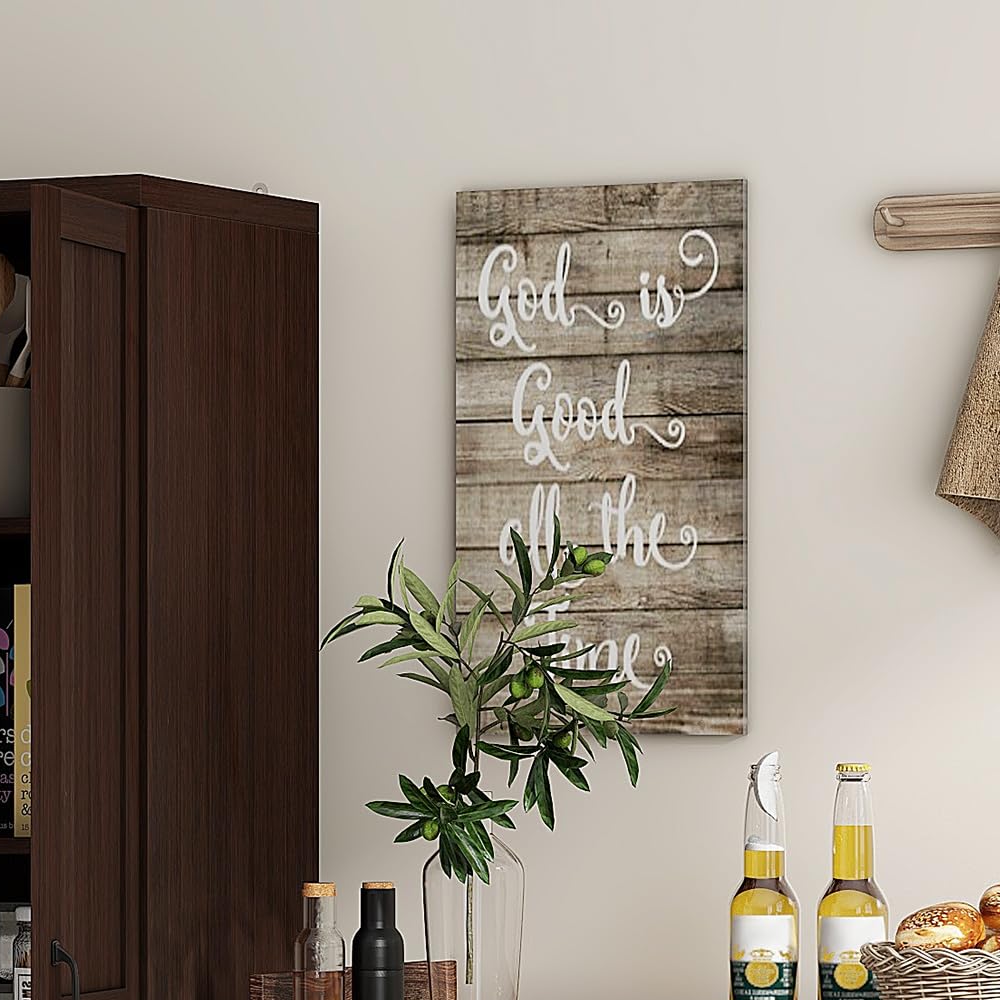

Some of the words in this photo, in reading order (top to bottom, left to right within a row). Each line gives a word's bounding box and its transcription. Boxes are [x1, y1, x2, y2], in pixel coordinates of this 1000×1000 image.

[478, 241, 625, 352] God
[639, 229, 721, 328] is
[512, 359, 687, 472] Good
[499, 482, 578, 586] all
[588, 474, 698, 571] the
